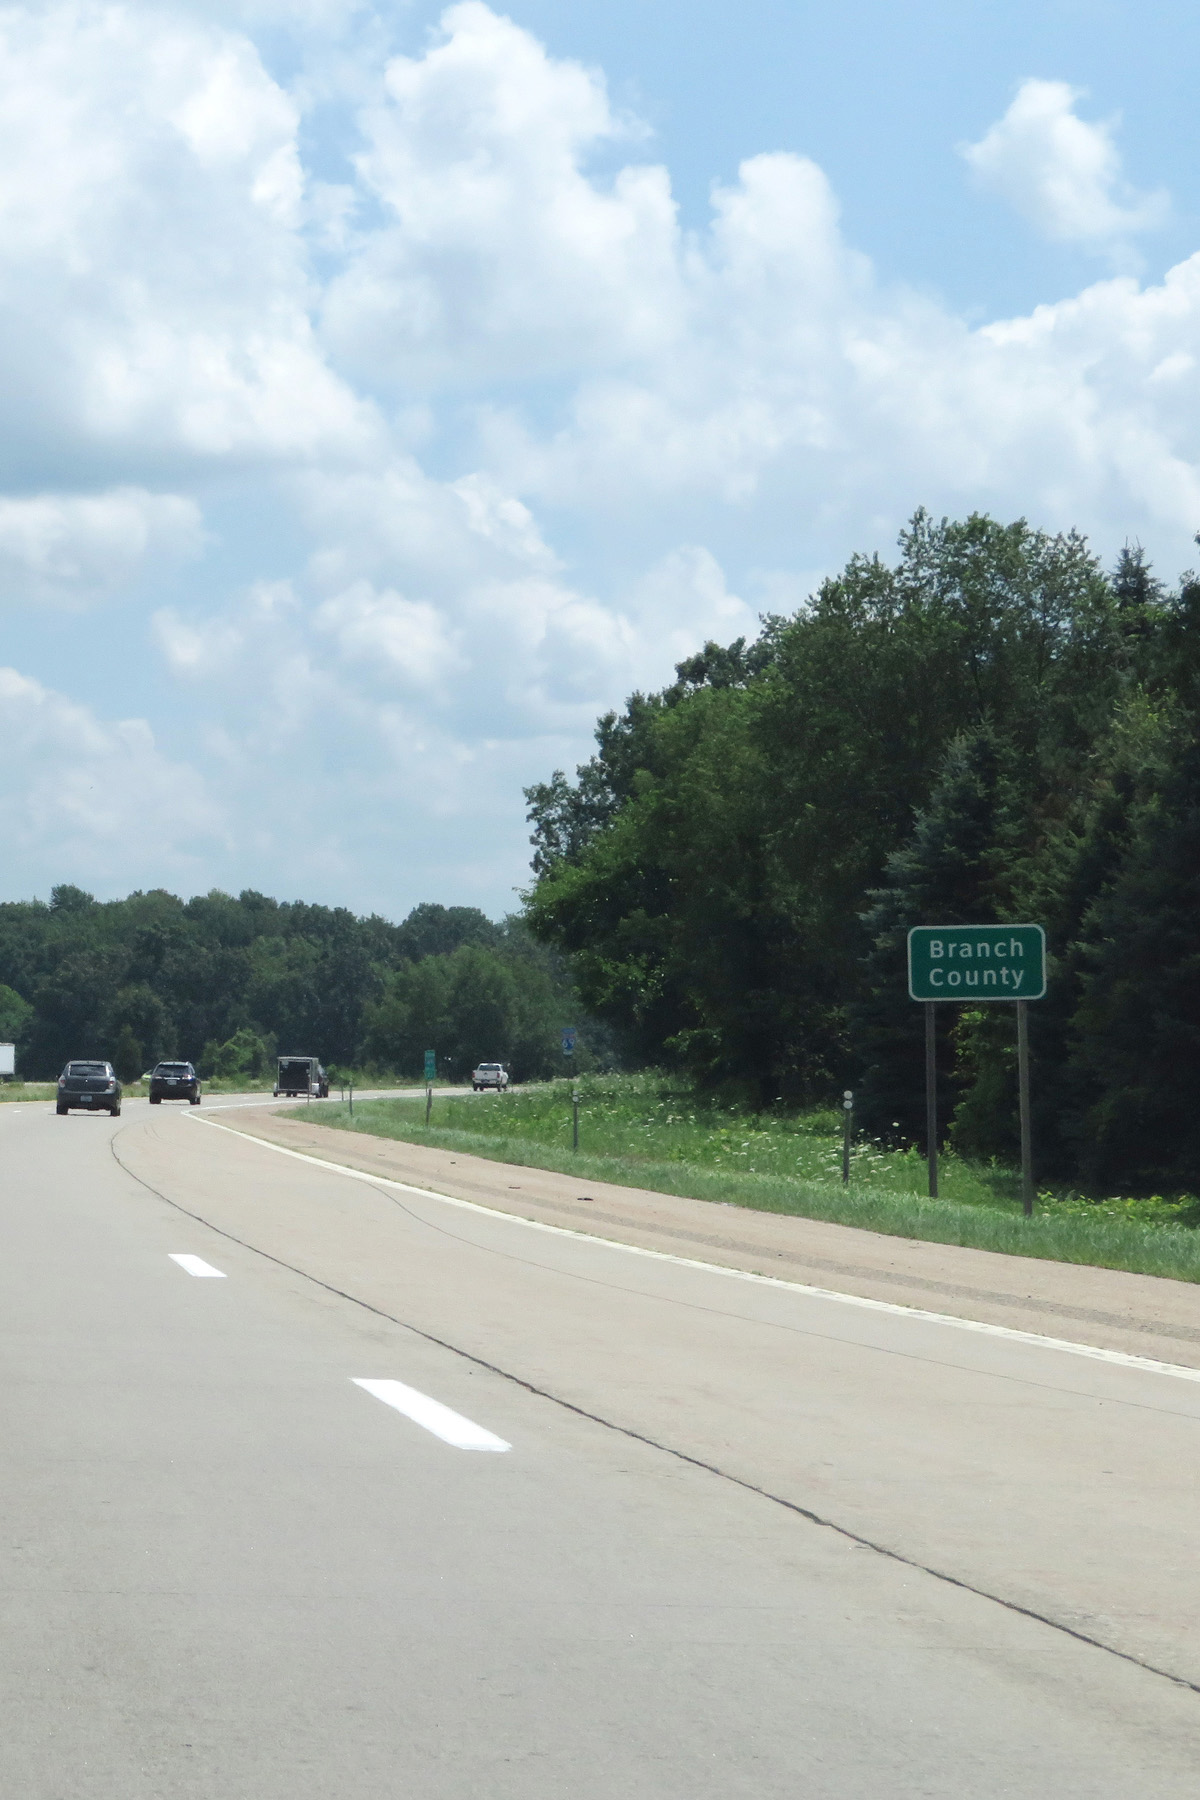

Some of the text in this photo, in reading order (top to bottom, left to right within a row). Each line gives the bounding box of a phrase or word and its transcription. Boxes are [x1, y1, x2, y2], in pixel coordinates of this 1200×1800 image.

[930, 937, 1023, 958] Branch
[929, 966, 1024, 990] County
[562, 1038, 575, 1048] 69
